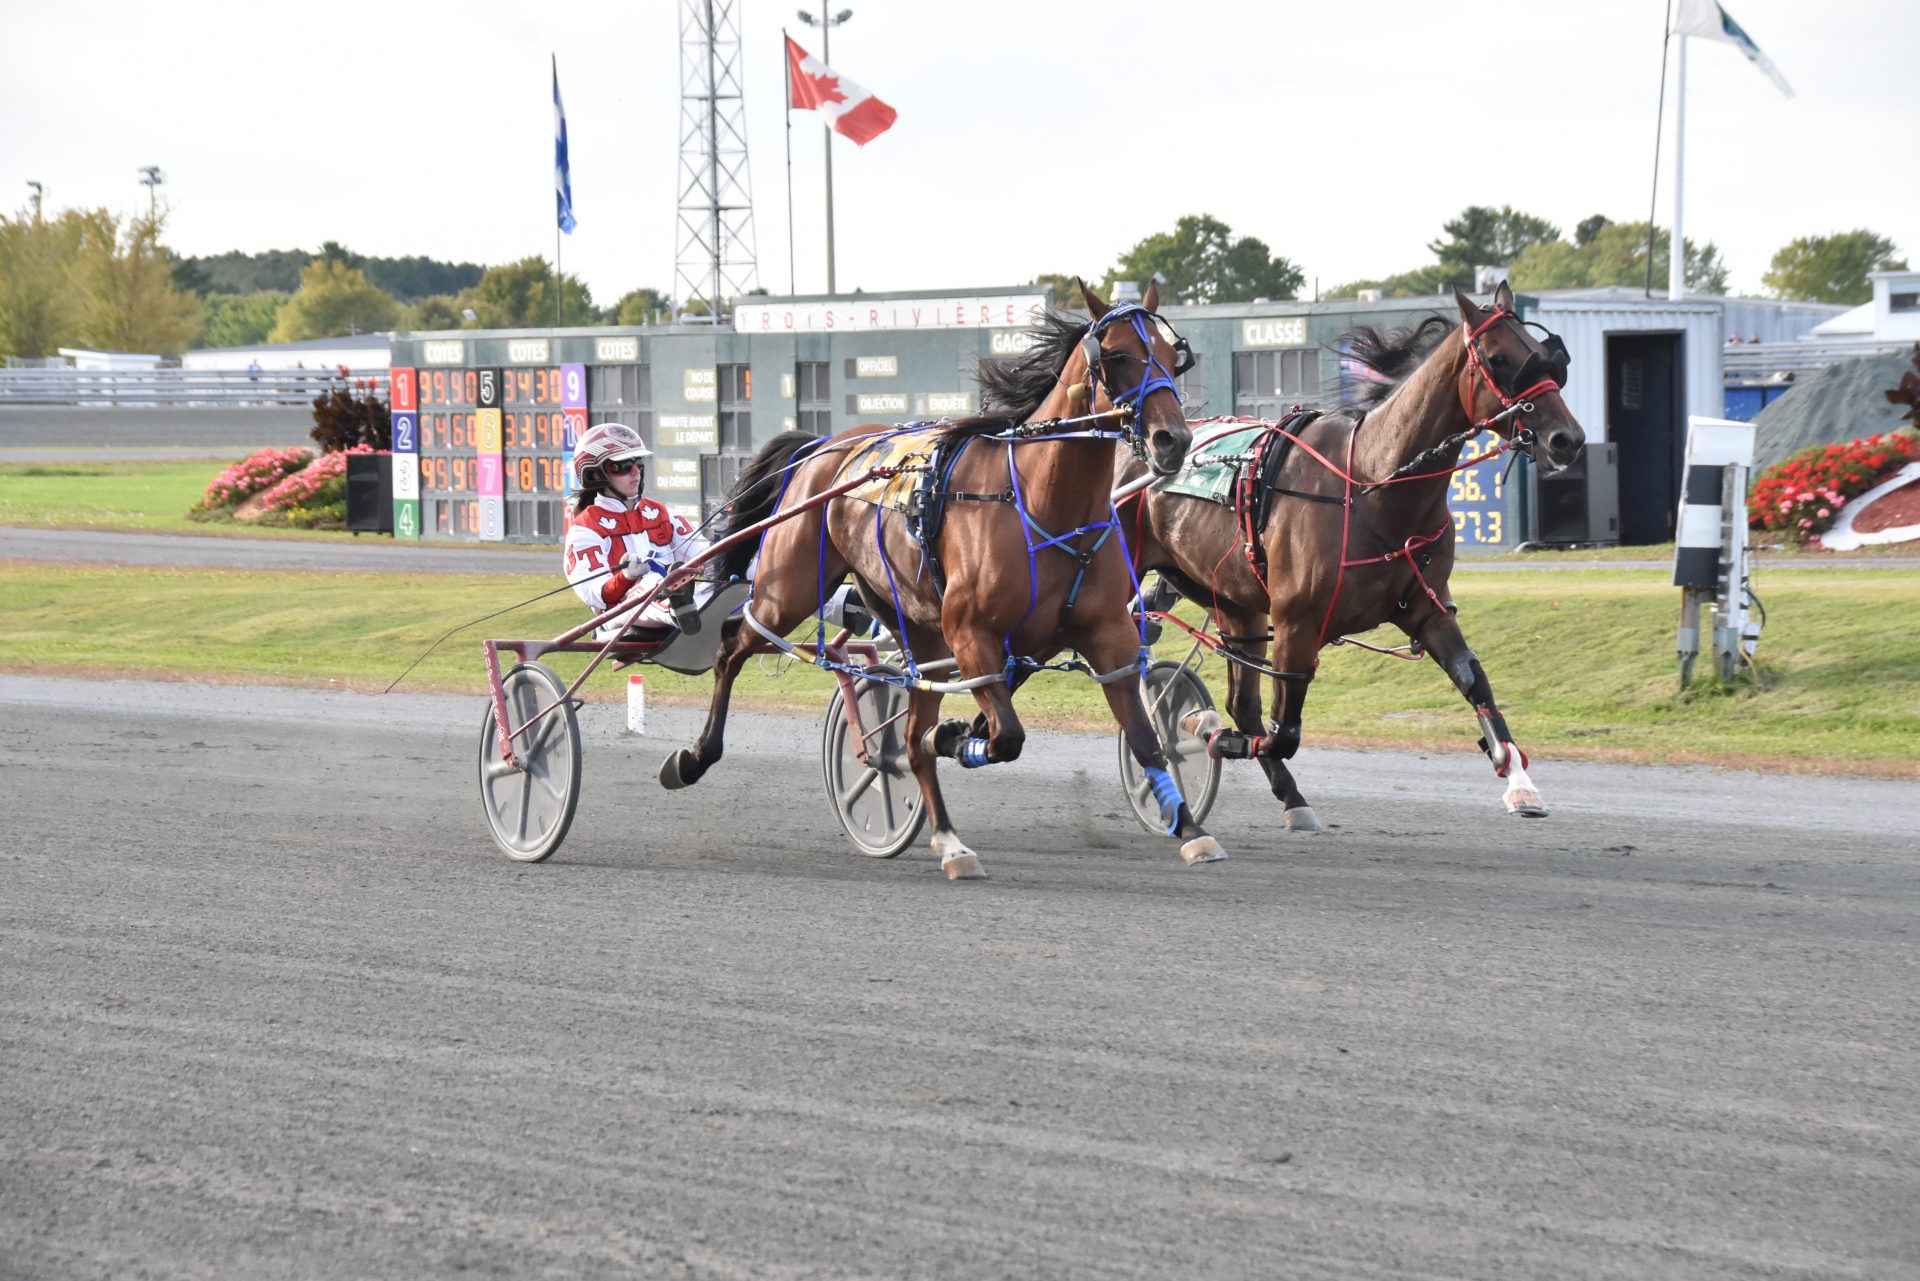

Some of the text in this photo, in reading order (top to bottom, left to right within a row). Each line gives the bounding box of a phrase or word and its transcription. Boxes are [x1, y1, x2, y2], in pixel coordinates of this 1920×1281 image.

[1246, 319, 1302, 344] CLASSÉ
[425, 342, 461, 362] COTES
[510, 341, 546, 362] COTES
[598, 340, 635, 361] COTES
[859, 359, 893, 373] OFFICIEL
[396, 373, 408, 406] 1
[480, 370, 495, 405] 5
[567, 370, 580, 402] 9
[784, 376, 791, 394] 1
[860, 397, 905, 410] OBJECTION
[929, 395, 968, 411] ENQUÊTE
[397, 416, 412, 450] 2
[482, 413, 497, 449] 6
[399, 459, 411, 492] 3
[483, 458, 497, 491] 7
[399, 503, 414, 536] 4
[485, 500, 497, 536] 8
